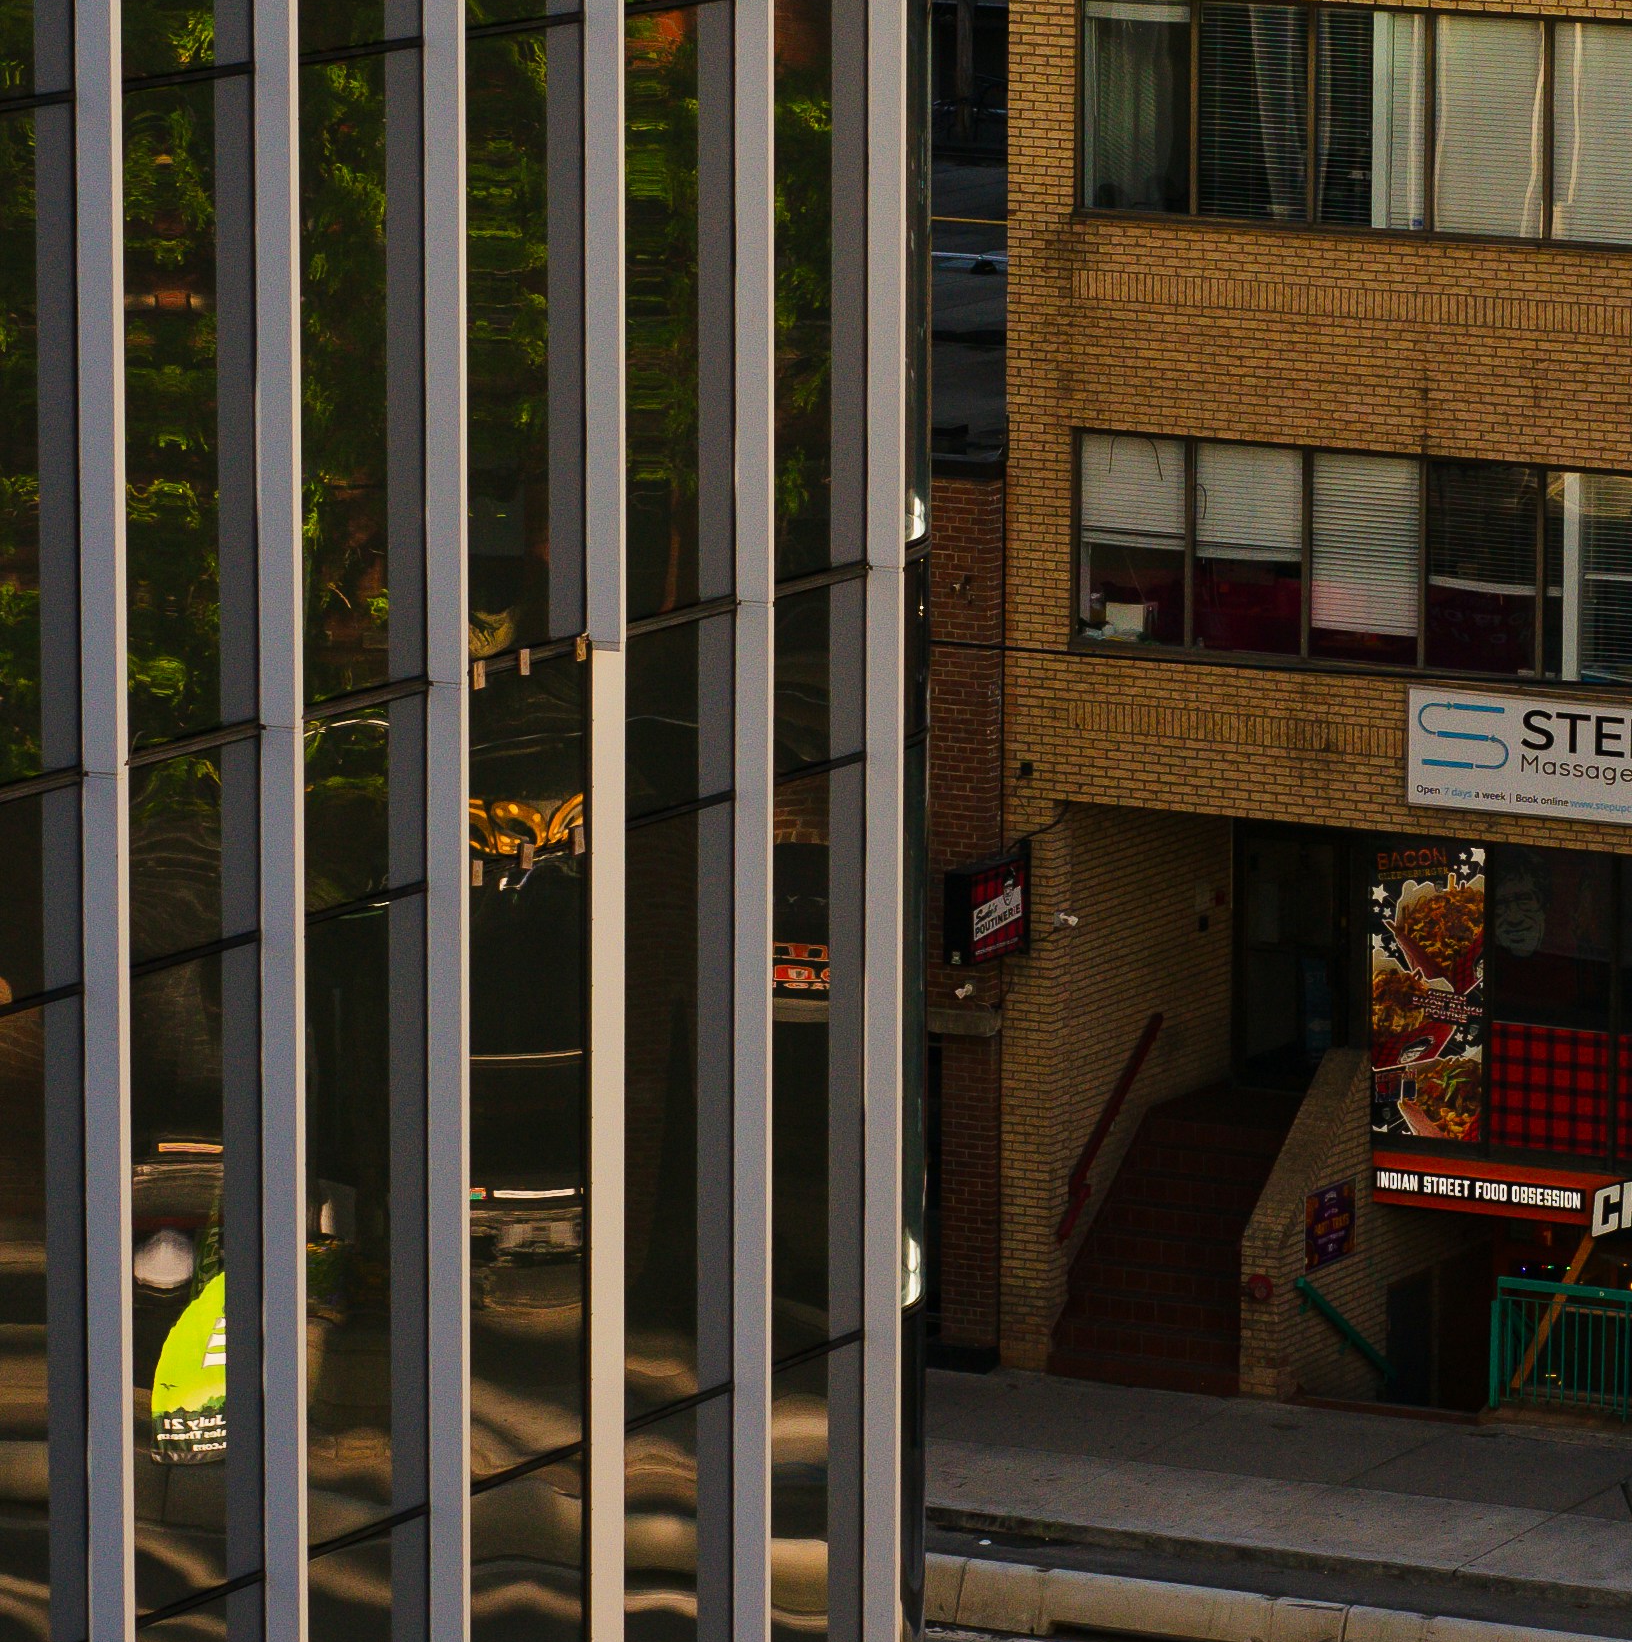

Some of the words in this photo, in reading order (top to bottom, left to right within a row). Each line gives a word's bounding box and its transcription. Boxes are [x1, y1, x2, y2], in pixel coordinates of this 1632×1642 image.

[1416, 784, 1441, 795] Open
[1451, 788, 1473, 799] days
[1474, 790, 1480, 799] a
[1482, 790, 1506, 801] week
[1515, 793, 1539, 805] Book
[1540, 797, 1569, 807] online
[1376, 846, 1448, 871] BACON
[975, 903, 1021, 935] POUTINERIE
[1376, 1169, 1419, 1193] INDIAN
[1423, 1174, 1471, 1198] STREET
[1475, 1180, 1508, 1203] FOOD
[1511, 1184, 1582, 1210] OBSESSION
